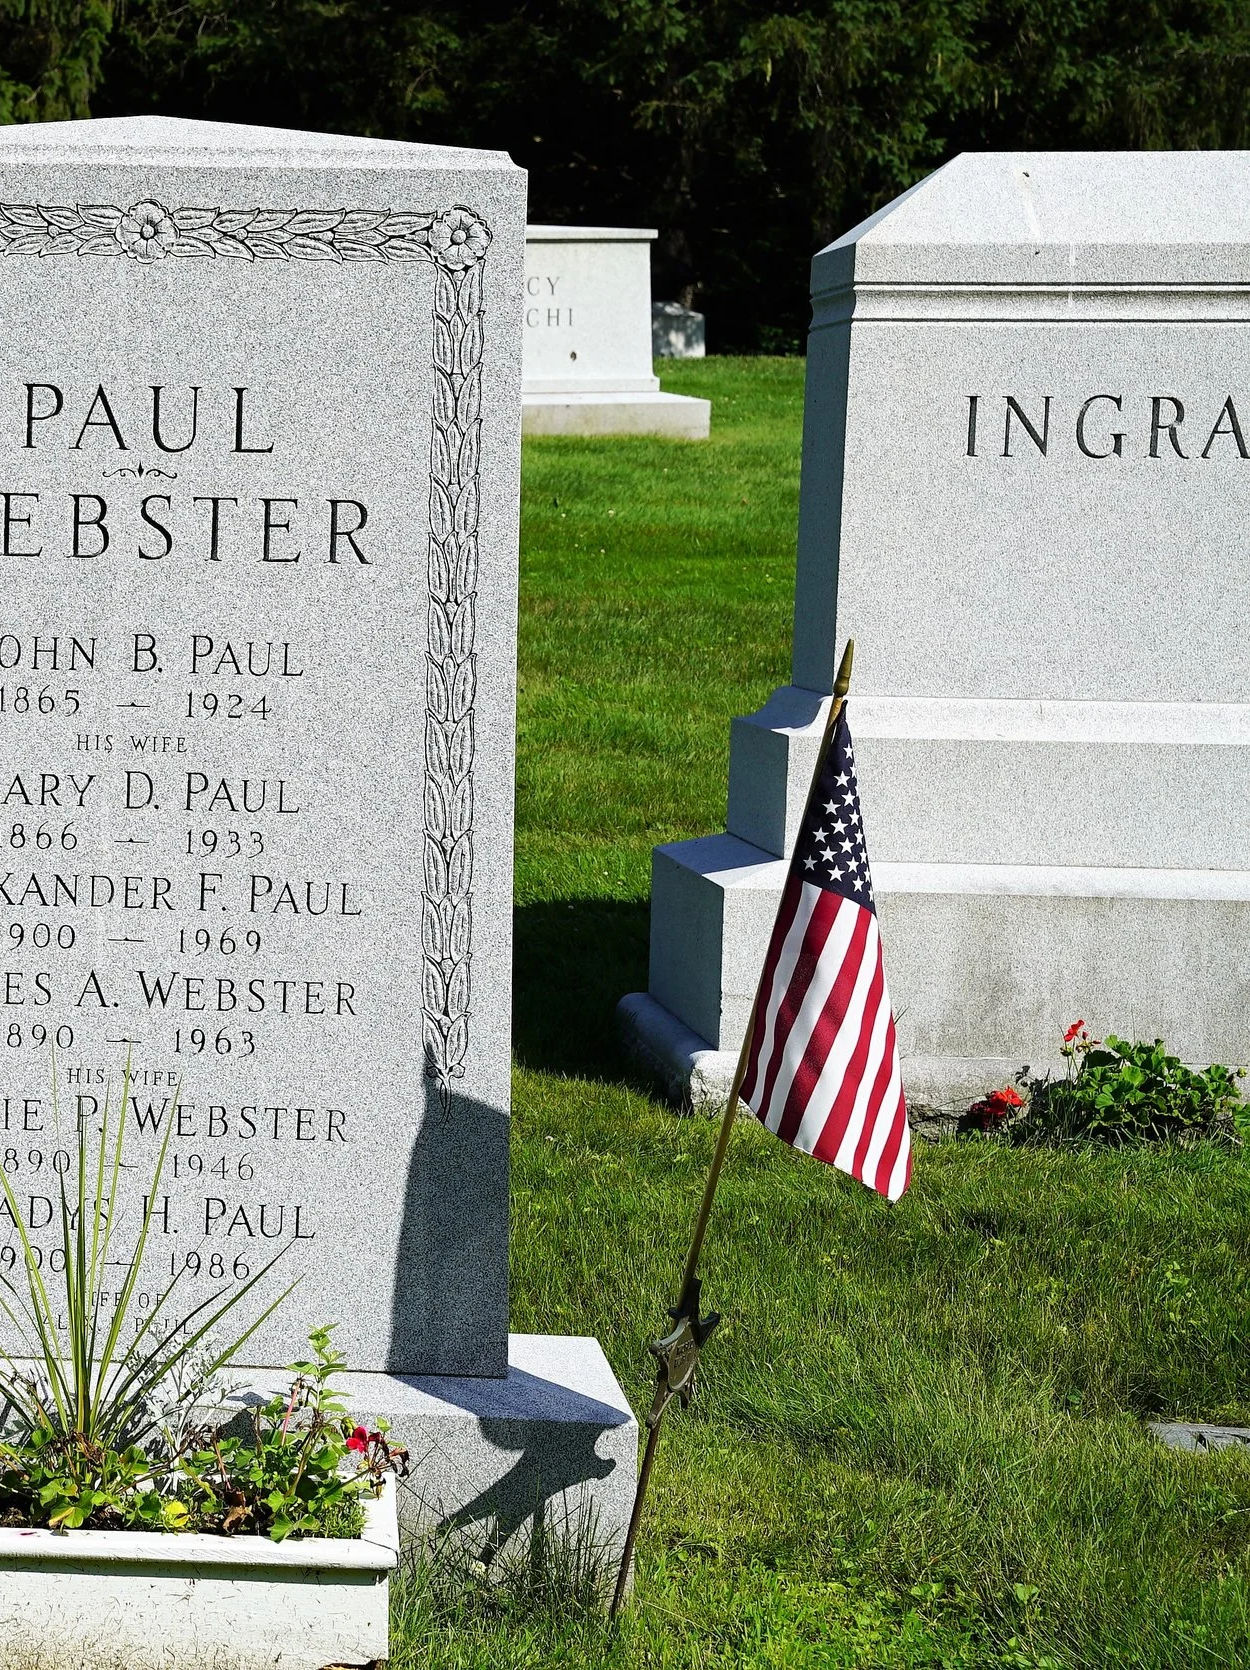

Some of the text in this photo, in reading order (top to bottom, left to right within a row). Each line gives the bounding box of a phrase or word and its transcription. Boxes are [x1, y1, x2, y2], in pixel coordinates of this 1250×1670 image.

[527, 276, 560, 296] CY
[526, 307, 573, 328] CHI
[21, 382, 275, 455] PAUL
[963, 393, 1250, 460] INGRA
[131, 632, 164, 674] B.
[190, 634, 304, 678] PAUL
[185, 690, 273, 720] 1924
[76, 734, 188, 754] HIS WIFE
[125, 770, 160, 810] D.
[184, 771, 299, 815] PAUL
[185, 826, 266, 856] 1933
[197, 871, 229, 913] F.
[248, 874, 362, 916] PAUL
[177, 927, 263, 956] 1969
[74, 970, 120, 1009] A.
[136, 971, 358, 1016] WEBSTER
[174, 1027, 256, 1054] 1963
[67, 1067, 178, 1087] HIS WIFE
[74, 1095, 104, 1133] P.
[128, 1096, 349, 1142] WEBSTER
[173, 1152, 255, 1181] 1946
[140, 1194, 179, 1234] H.
[203, 1197, 316, 1239] PAUL
[170, 1251, 251, 1280] 1986
